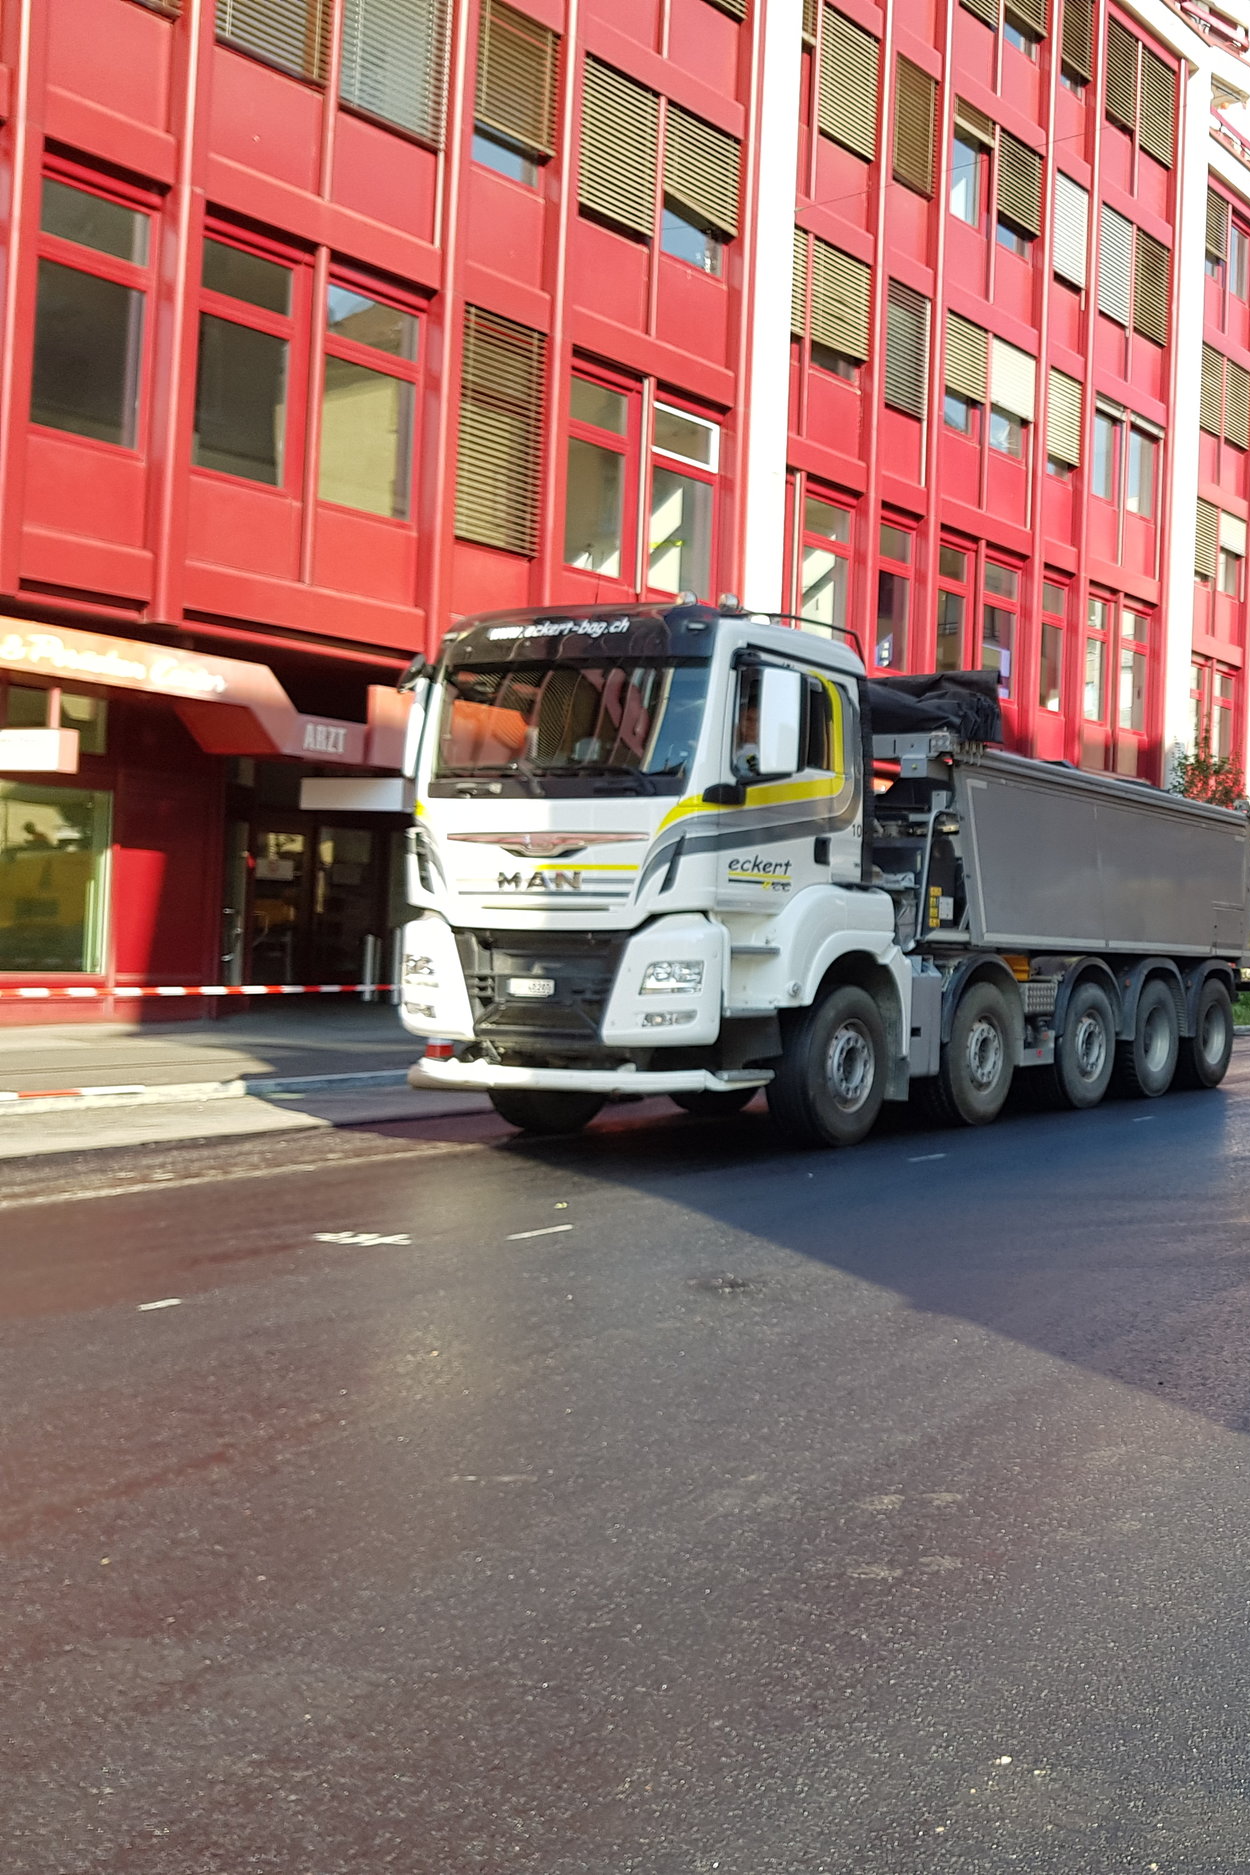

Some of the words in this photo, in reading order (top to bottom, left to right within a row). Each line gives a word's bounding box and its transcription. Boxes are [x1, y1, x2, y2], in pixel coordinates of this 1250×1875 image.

[303, 722, 347, 754] ARZT
[728, 854, 792, 876] eckert
[497, 871, 582, 890] MAN
